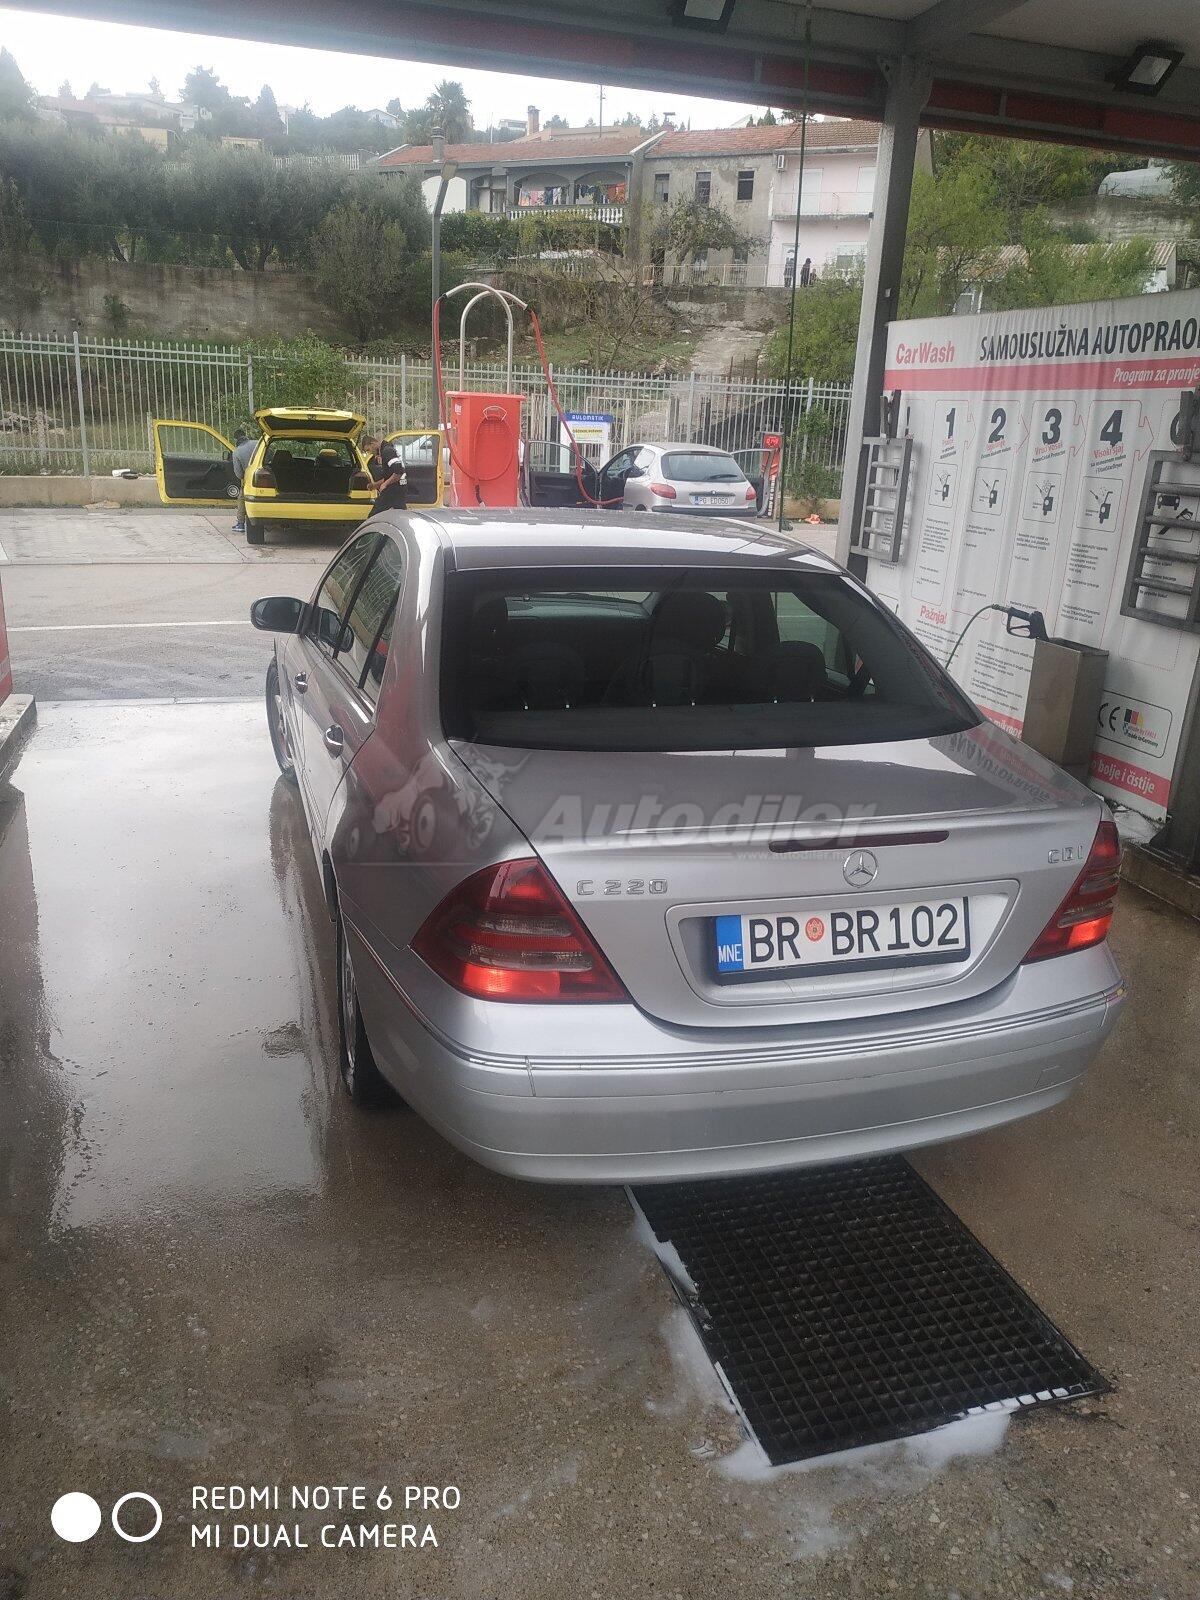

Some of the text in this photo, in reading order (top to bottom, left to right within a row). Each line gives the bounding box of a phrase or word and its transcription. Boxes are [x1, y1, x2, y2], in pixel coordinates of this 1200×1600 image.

[979, 324, 1089, 362] SAMOUSLUŽNA
[1091, 317, 1200, 356] AUTOPRAO
[1113, 364, 1200, 386] Program za pranje
[946, 407, 956, 439] 1
[988, 407, 1007, 444] 2
[1042, 408, 1062, 445] 3
[1100, 409, 1123, 447] 4
[920, 605, 948, 625] Pažnja!
[1098, 759, 1120, 780] bolje
[1122, 768, 1127, 782] i
[1047, 845, 1083, 864] CDI
[576, 877, 669, 896] C 220
[749, 916, 801, 963] BR
[717, 944, 743, 964] MNE
